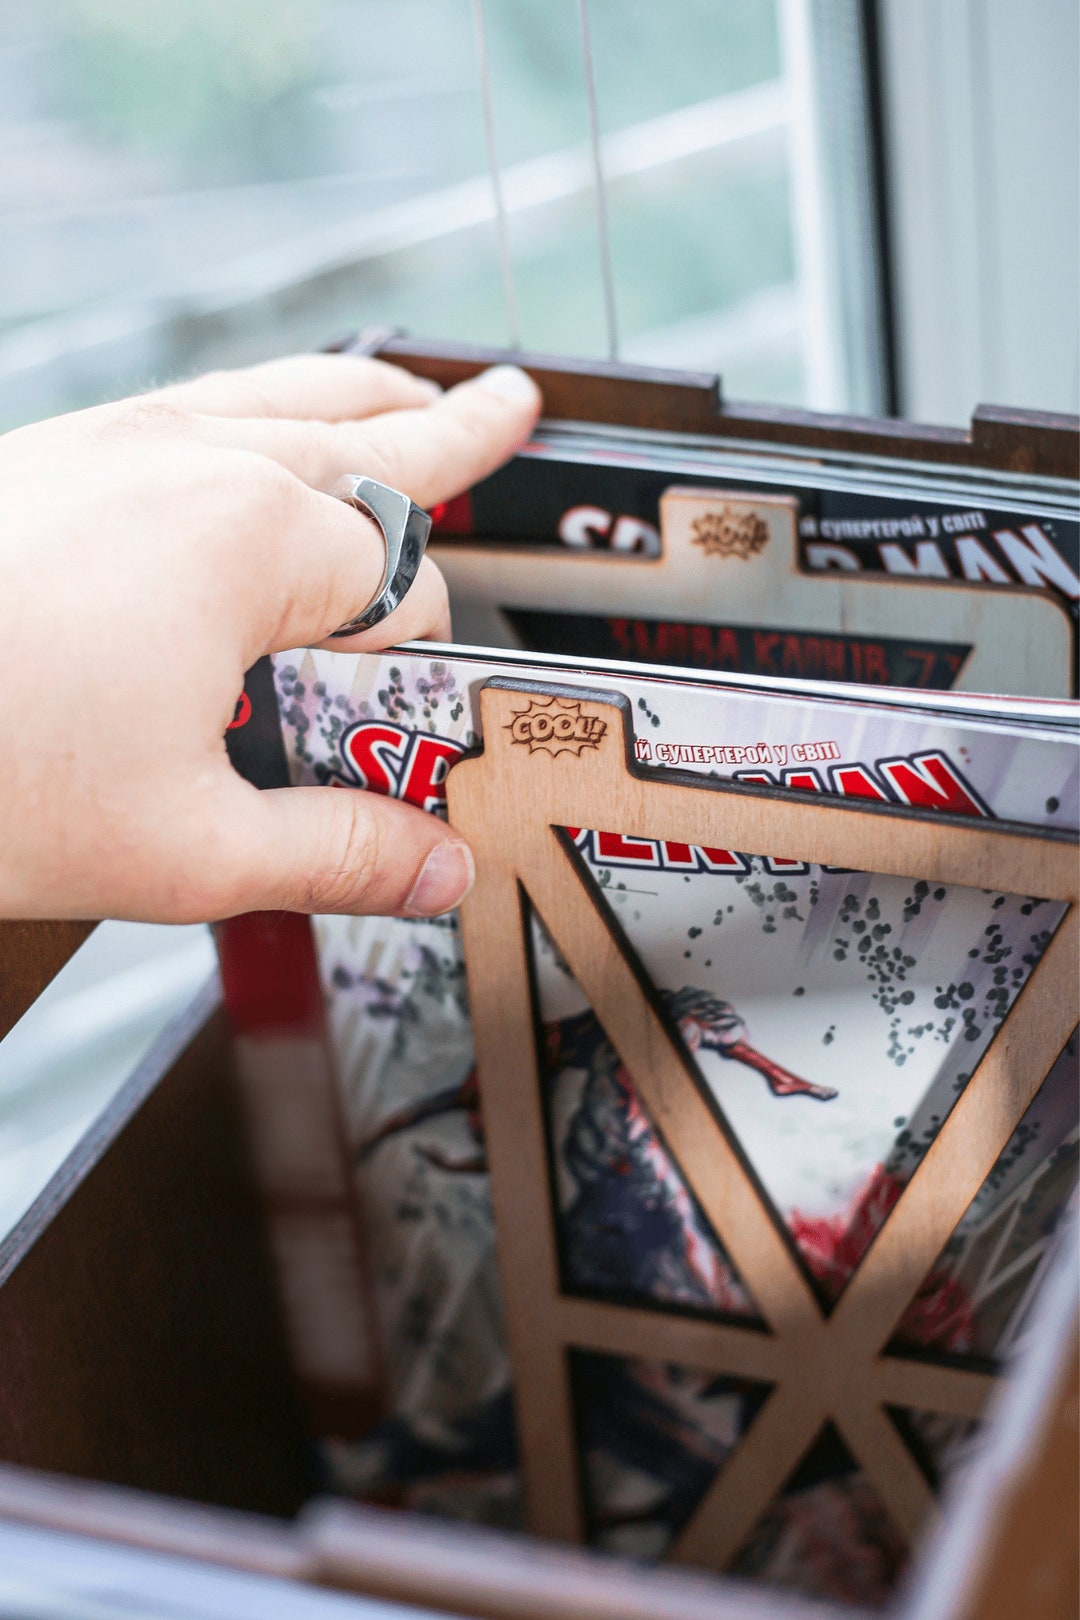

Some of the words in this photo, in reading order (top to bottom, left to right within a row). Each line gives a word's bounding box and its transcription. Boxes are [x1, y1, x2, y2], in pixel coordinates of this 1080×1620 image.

[820, 514, 925, 541] СУПЕРГЕРОЙ
[941, 511, 987, 533] СВІТІ
[655, 742, 773, 765] СУПЕРГЕРОЙ
[791, 740, 841, 763] СВІТІ
